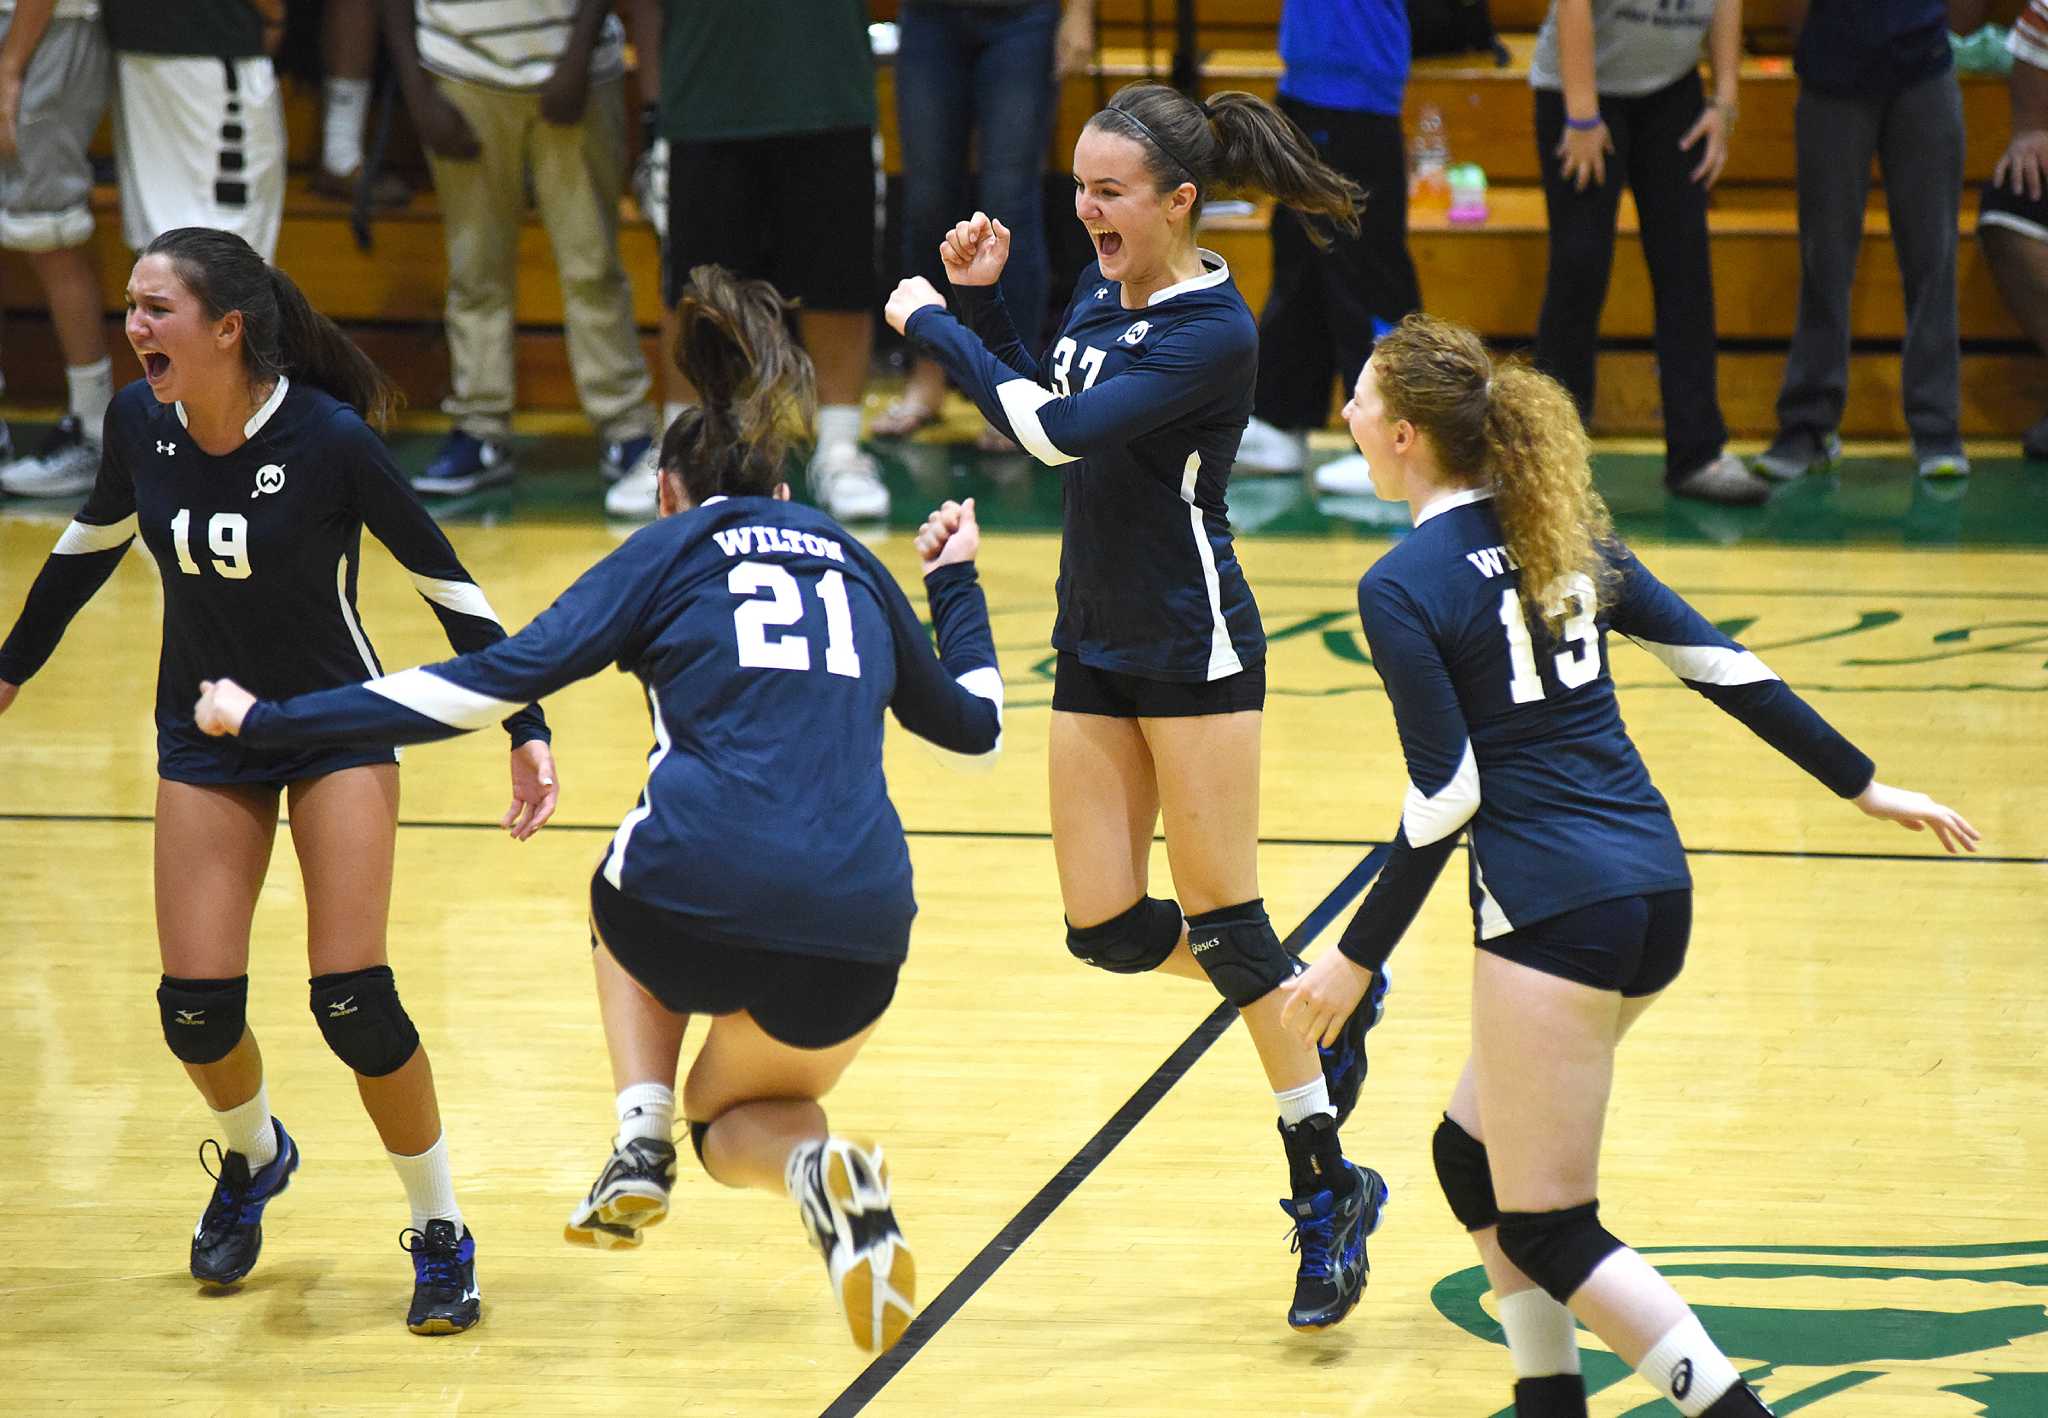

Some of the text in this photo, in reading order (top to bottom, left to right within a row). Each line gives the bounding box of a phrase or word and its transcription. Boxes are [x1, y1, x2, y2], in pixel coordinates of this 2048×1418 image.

[1051, 336, 1107, 399] 37
[171, 509, 253, 579] 19
[712, 526, 846, 563] WILTON
[728, 561, 861, 678] 21
[1499, 571, 1601, 704] 13
